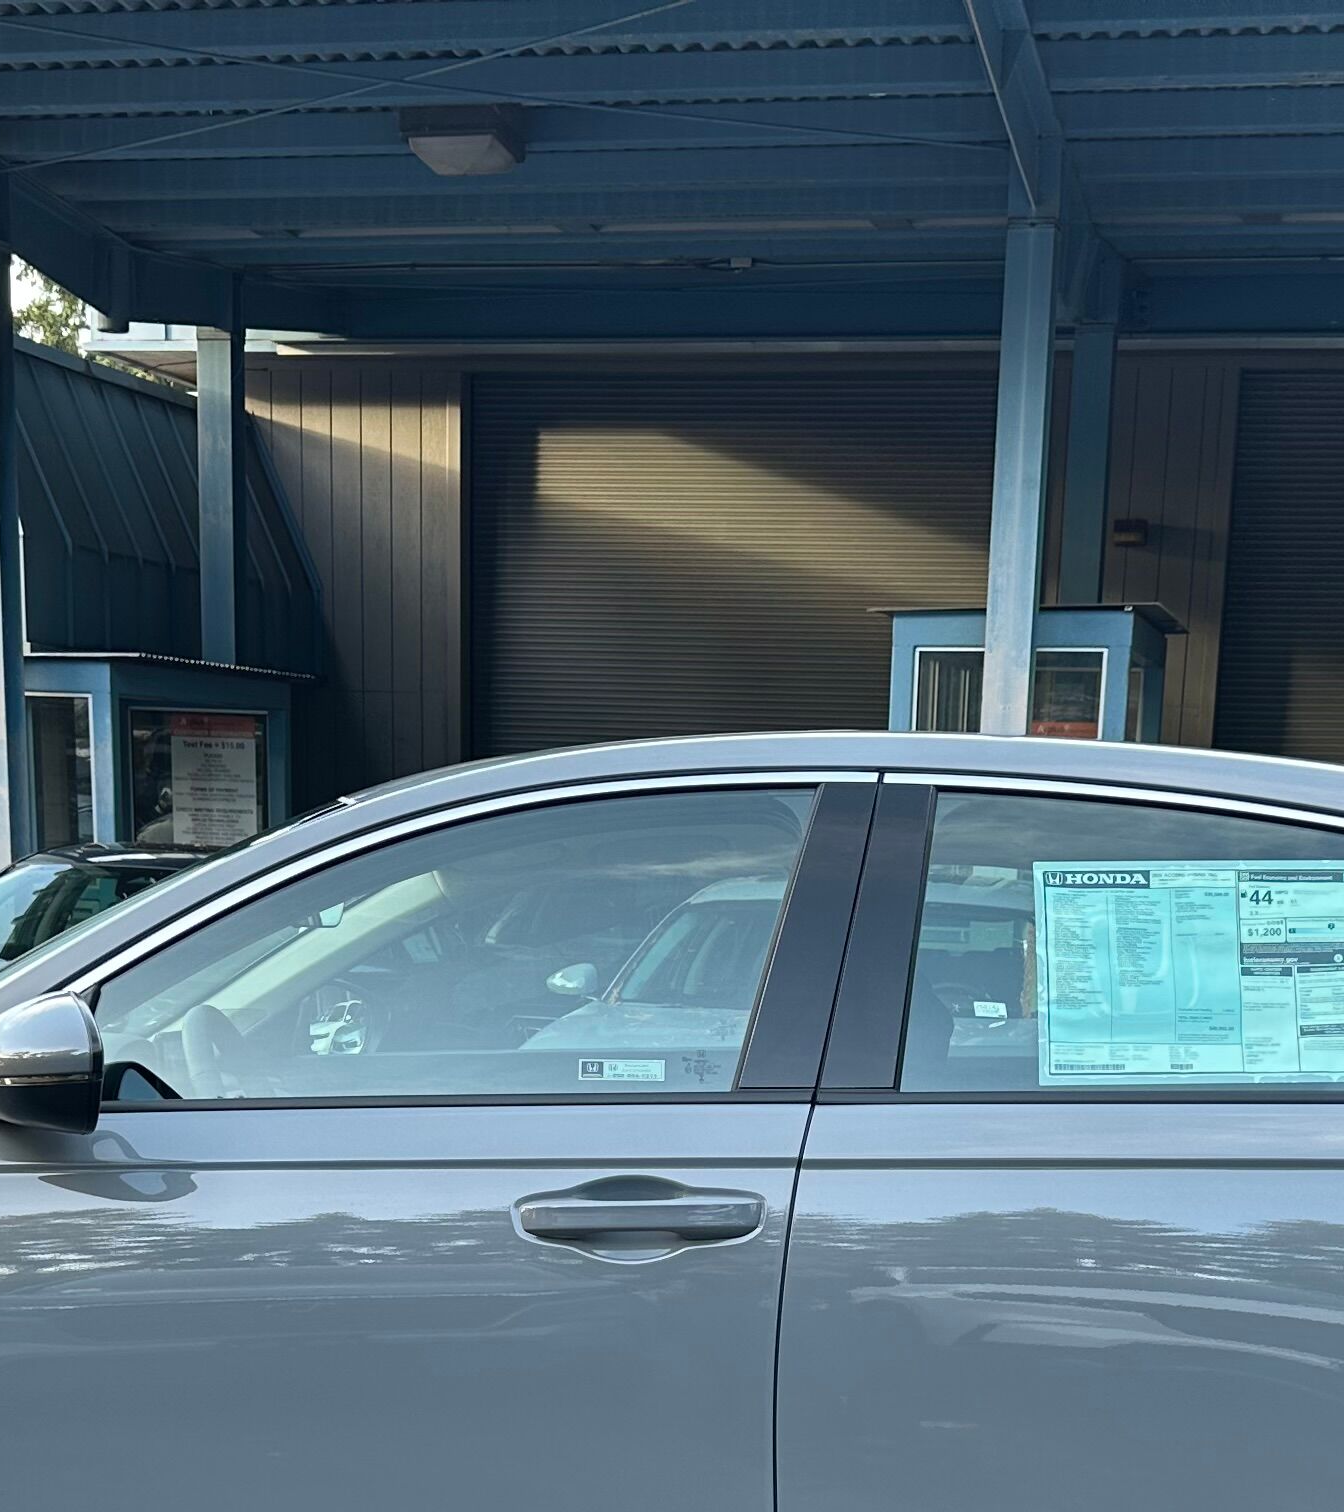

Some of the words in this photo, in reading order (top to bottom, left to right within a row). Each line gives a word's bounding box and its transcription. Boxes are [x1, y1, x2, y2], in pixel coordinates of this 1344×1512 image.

[1065, 873, 1148, 885] HONDA
[1250, 889, 1274, 905] 44
[1247, 927, 1282, 937] $1,200
